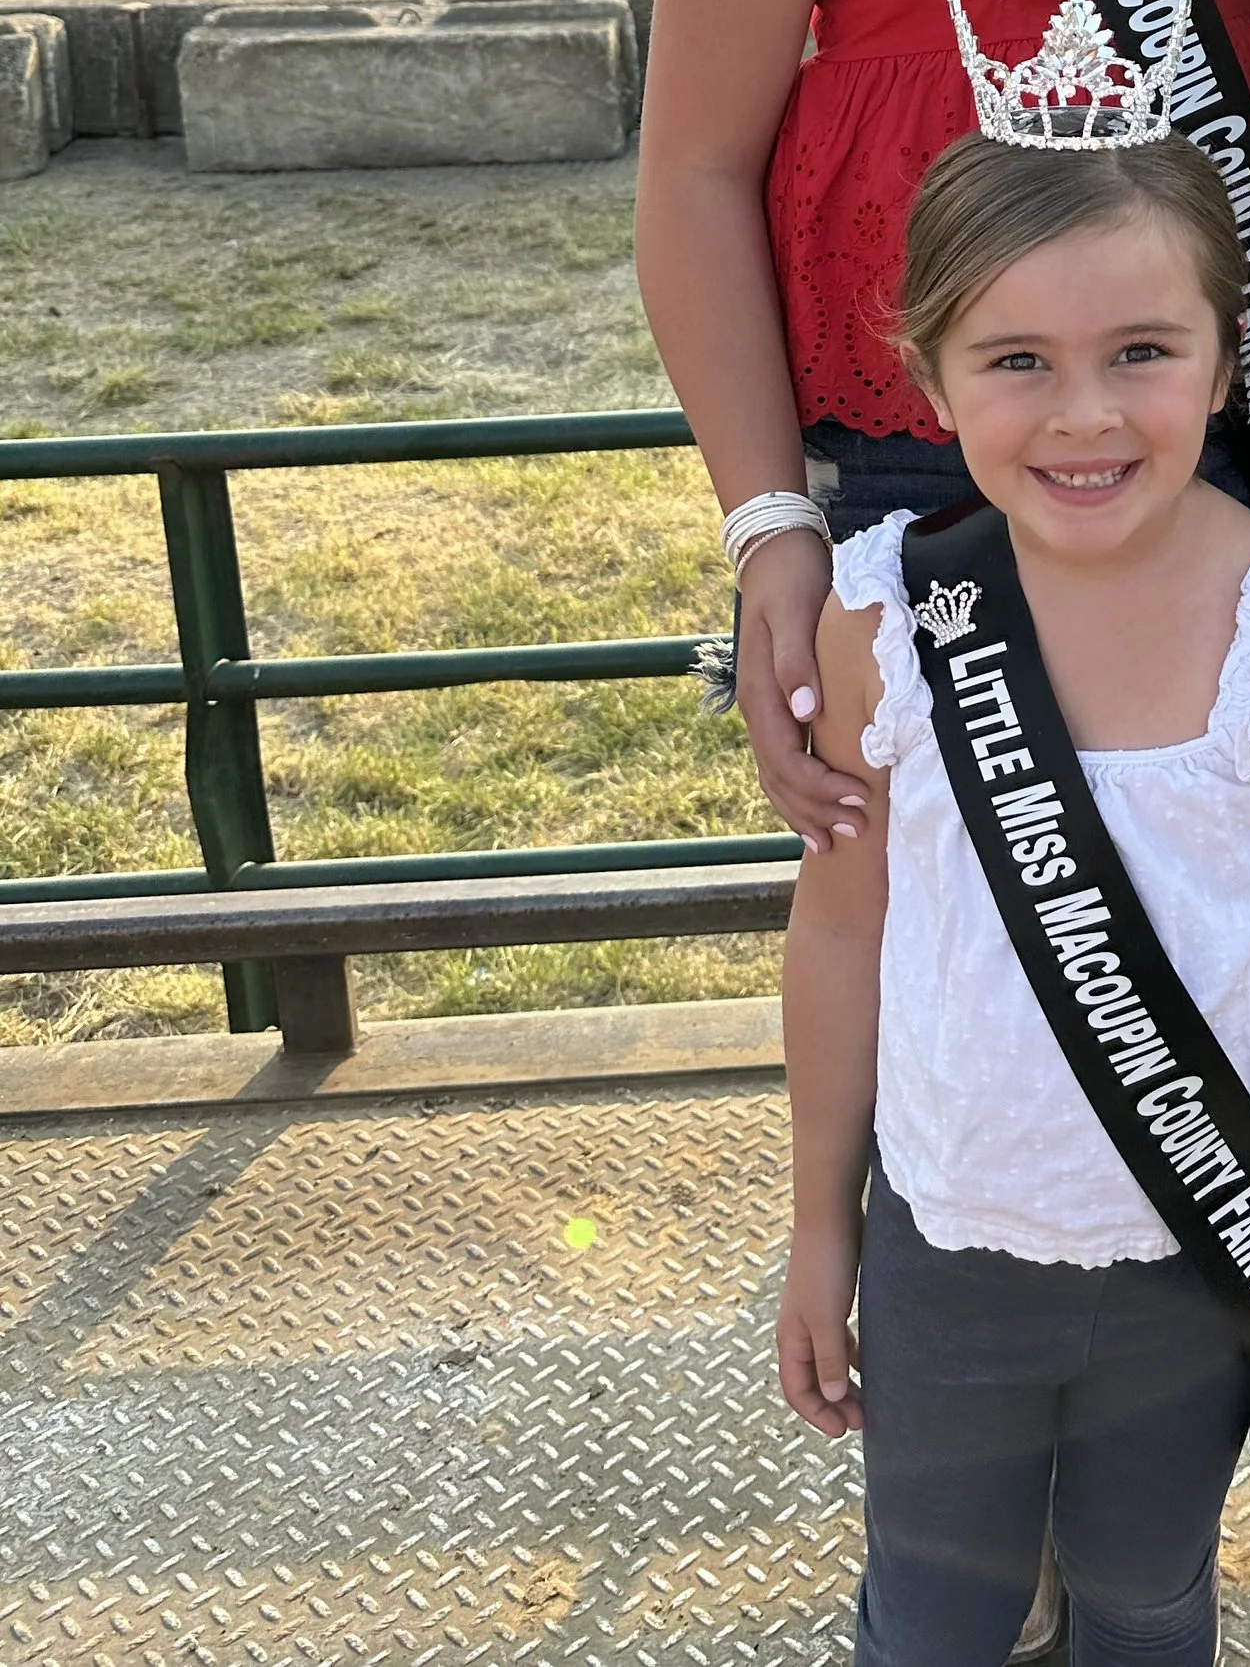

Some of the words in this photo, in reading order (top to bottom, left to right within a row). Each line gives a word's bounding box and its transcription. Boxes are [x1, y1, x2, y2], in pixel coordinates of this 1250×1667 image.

[949, 642, 1033, 781] LITTLE
[991, 781, 1076, 886] MISS
[1035, 887, 1177, 1086] MACOUPIN
[1137, 1076, 1245, 1201] COUNTY
